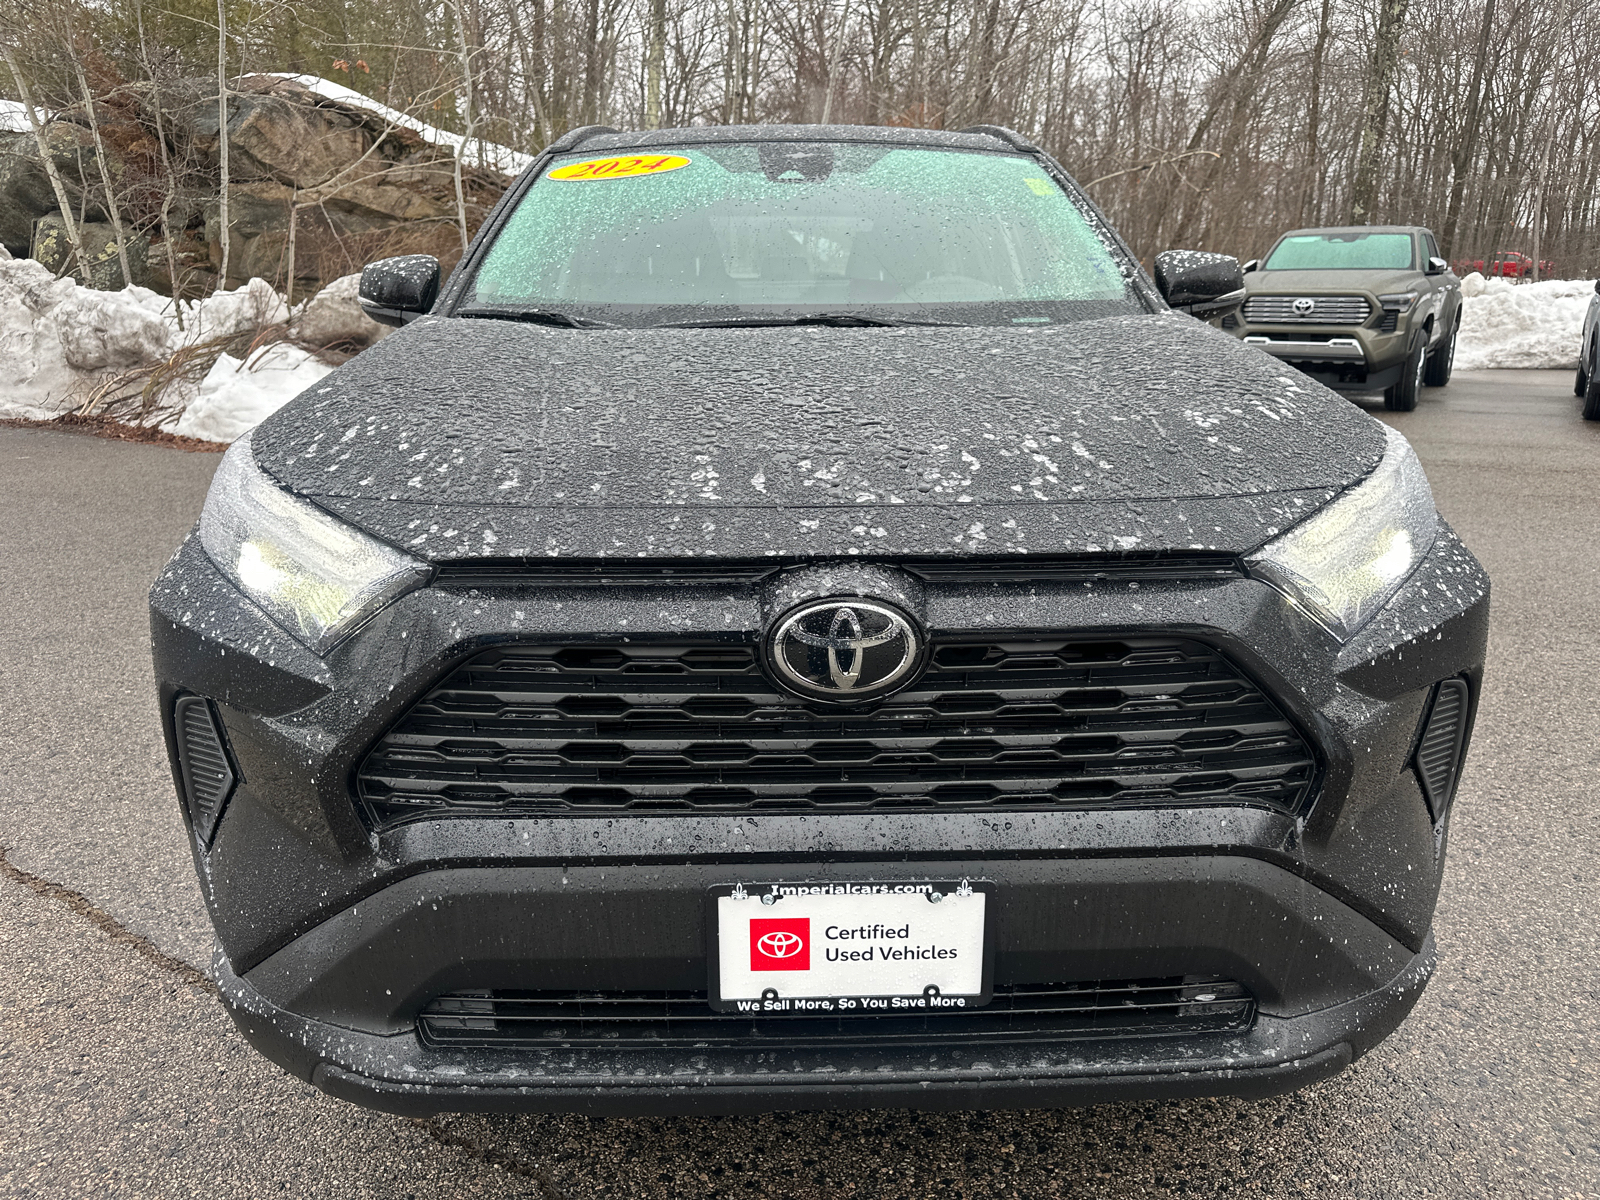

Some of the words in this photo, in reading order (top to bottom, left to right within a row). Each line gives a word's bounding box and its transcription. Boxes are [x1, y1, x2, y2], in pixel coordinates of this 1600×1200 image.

[565, 156, 672, 179] 2024
[771, 883, 933, 896] Imperialcars.com
[825, 924, 909, 940] Certified
[826, 946, 874, 962] Used
[879, 945, 958, 961] Vehicles
[737, 1000, 761, 1012] We
[764, 999, 790, 1011] Sell
[794, 999, 835, 1011] More,
[838, 998, 857, 1009] So
[861, 997, 888, 1009] You
[892, 996, 926, 1008] Save
[930, 996, 966, 1008] More
